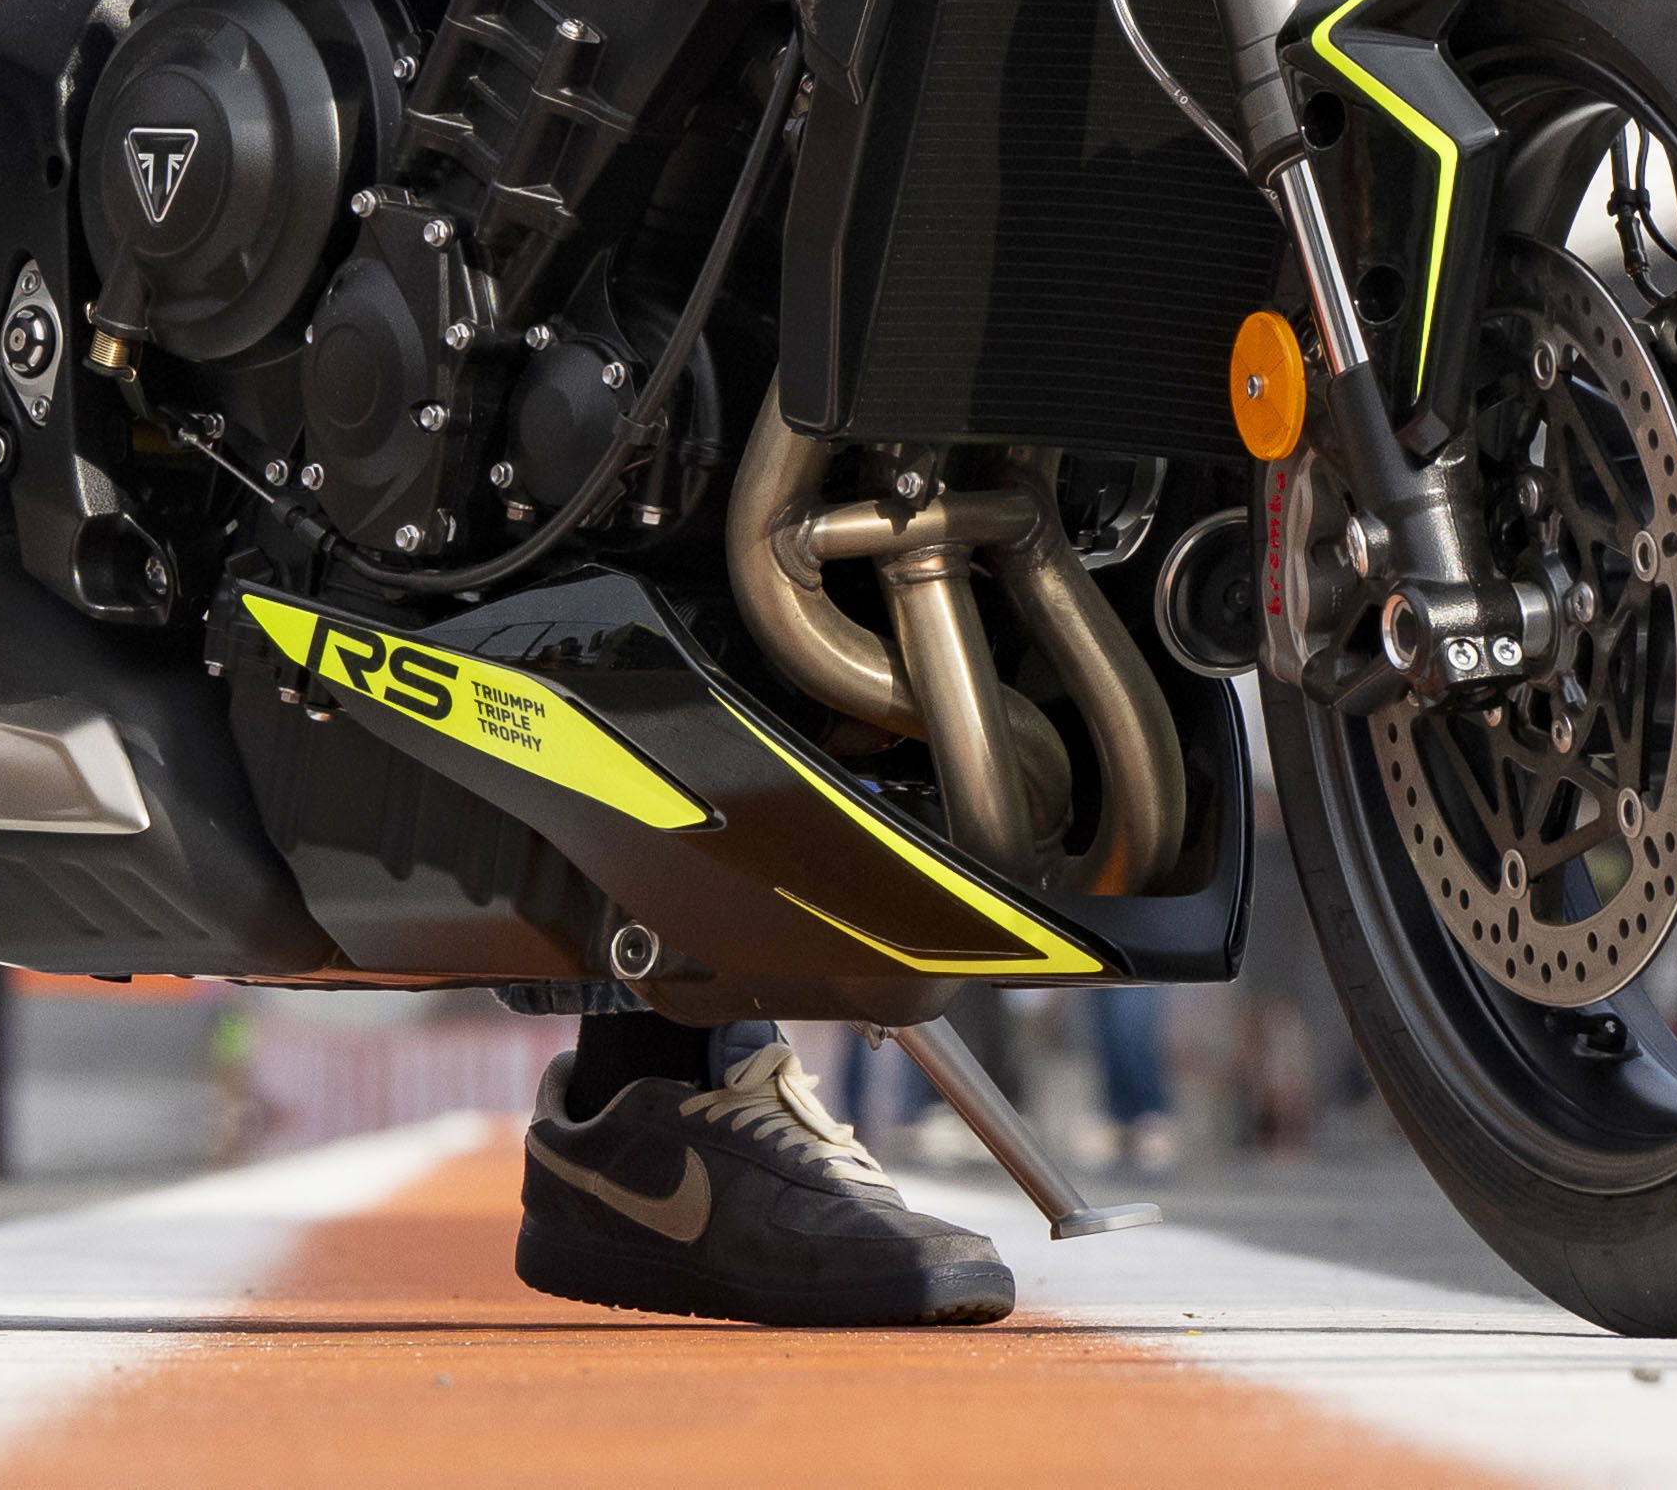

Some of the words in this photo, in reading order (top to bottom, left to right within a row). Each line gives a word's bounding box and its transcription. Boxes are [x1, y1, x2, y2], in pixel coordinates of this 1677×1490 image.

[306, 615, 459, 721] RS
[470, 680, 546, 719] TRIUMPH
[473, 698, 532, 732] TRIPLE
[476, 717, 542, 753] TROPHY
